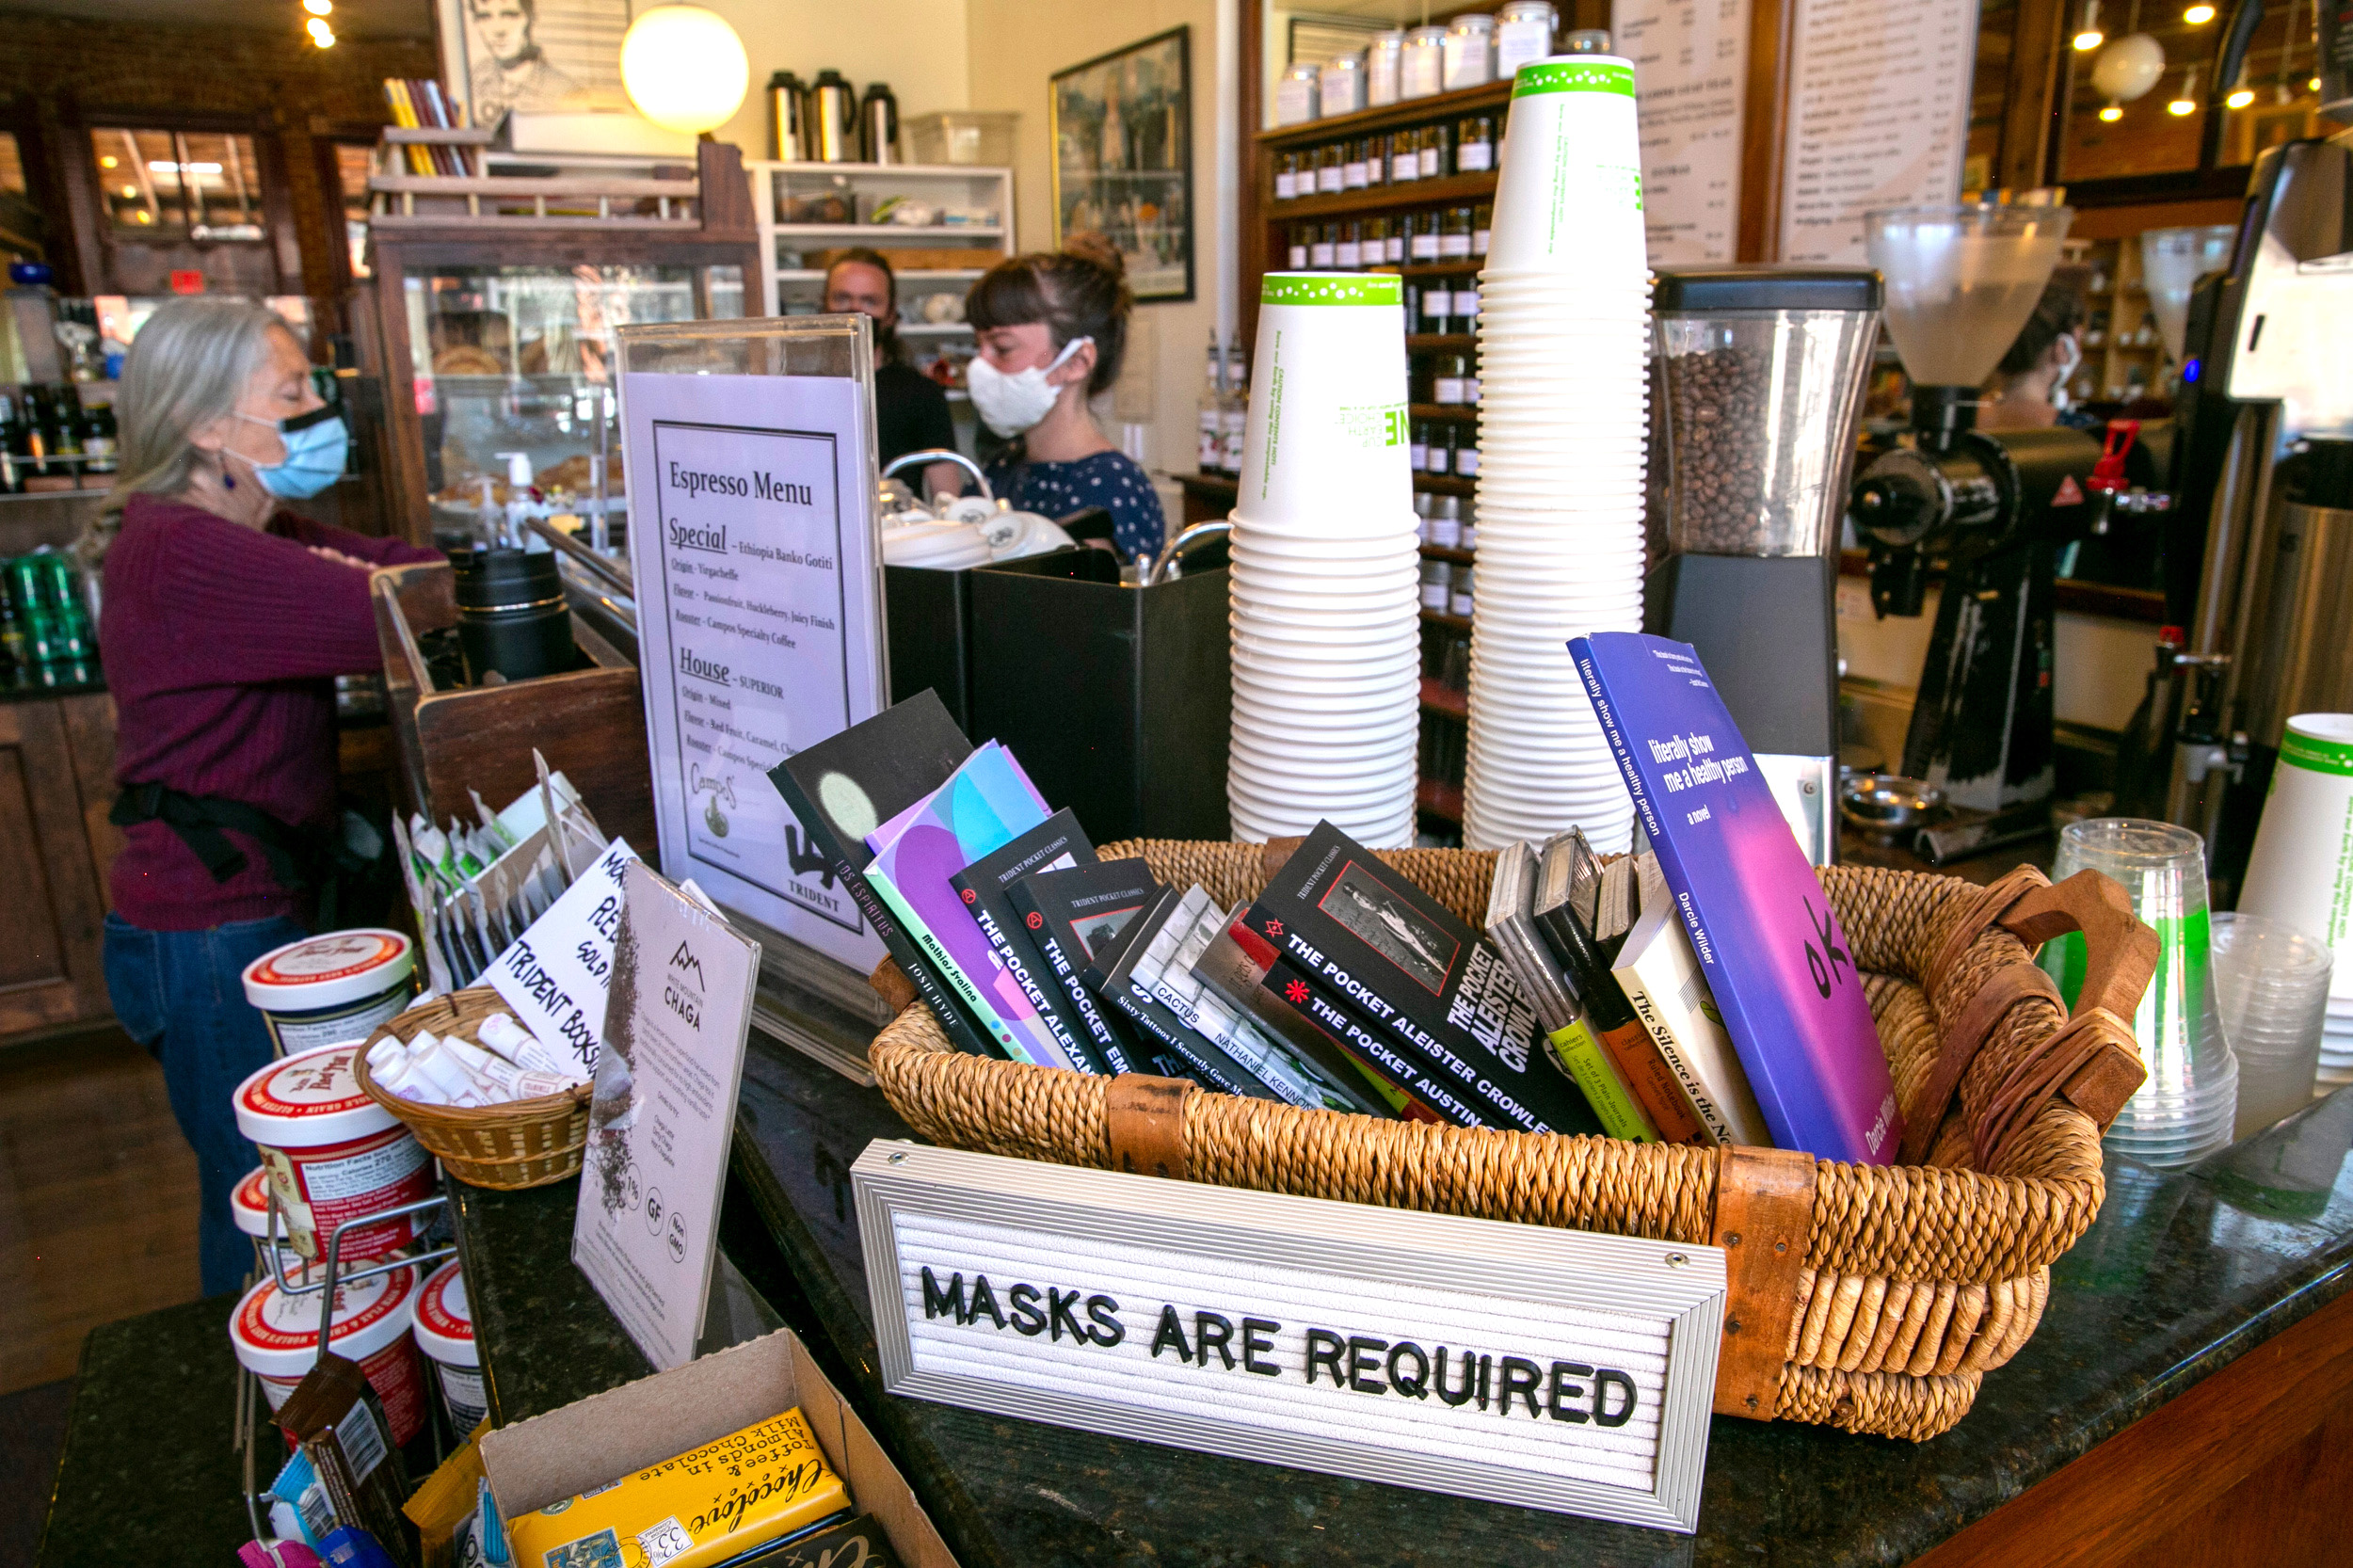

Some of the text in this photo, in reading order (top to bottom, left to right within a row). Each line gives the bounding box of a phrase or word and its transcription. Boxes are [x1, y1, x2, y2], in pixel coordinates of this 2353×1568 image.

[669, 461, 812, 505] Espresso Menu
[669, 518, 834, 570] Special Ethiopia Banko Gotiti
[771, 632, 796, 649] Coffee
[810, 616, 835, 631] Finish
[680, 647, 784, 699] House SUPERIOR
[1580, 658, 1661, 837] literally show me a healthy person
[1648, 731, 1715, 765] literally show
[1663, 755, 1749, 793] me a healthy person
[1687, 804, 1712, 825] a novel
[1022, 850, 1045, 872] POCKET
[789, 879, 840, 913] TRIDENT
[835, 859, 894, 938] LOS ESPIRITUS
[1678, 891, 1715, 966] Darcie Wilder
[505, 939, 573, 1018] TRIDENT
[577, 940, 609, 977] SOLD
[921, 934, 979, 1003] Mathias Svalina
[977, 909, 1005, 947] THE
[999, 943, 1051, 1013] POCKET
[664, 985, 701, 1033] CHAGA
[908, 963, 959, 1029] JOSH HYDE
[1044, 937, 1131, 1077] THE POCKET EM
[1447, 942, 1495, 1032] THE POCKET
[1470, 957, 1517, 1056] ALEISTER
[1117, 996, 1142, 1019] Sixty
[1139, 1012, 1171, 1043] Tattoos
[1175, 1040, 1211, 1074] Secretly
[1209, 1066, 1232, 1088] Gave
[1157, 986, 1201, 1024] CACTUS
[1214, 1032, 1271, 1084] NATHANIEL
[1289, 934, 1554, 1137] THE POCKET ALEISTER CROWLE
[1498, 983, 1538, 1074] CROWLE
[1559, 1033, 1583, 1048] cahiers
[1562, 1040, 1587, 1053] collection
[1311, 997, 1482, 1128] THE POCKET AUSTIN
[1630, 990, 1652, 1025] The
[1651, 1022, 1691, 1080] Silence
[1686, 1081, 1700, 1096] is
[1695, 1096, 1716, 1123] the
[305, 1101, 342, 1114] GRAIN
[1583, 1058, 1593, 1070] Set
[1591, 1069, 1599, 1079] of
[1598, 1082, 1611, 1101] Plain
[1608, 1099, 1628, 1128] Journals
[1647, 1058, 1665, 1081] Ruled
[1661, 1080, 1687, 1121] Notebook
[305, 1154, 373, 1172] Nutrition Facts
[342, 1164, 374, 1177] Calories
[648, 1197, 663, 1223] GF
[672, 1215, 685, 1238] Non
[668, 1232, 684, 1256] GMO
[920, 1266, 1640, 1429] MASKS ARE REQUIRED
[639, 1416, 801, 1482] Milk Chocolate
[686, 1428, 805, 1478] Almonds in
[727, 1438, 815, 1479] Toffee &
[688, 1457, 824, 1535] Chocolove
[652, 1526, 685, 1560] 33%
